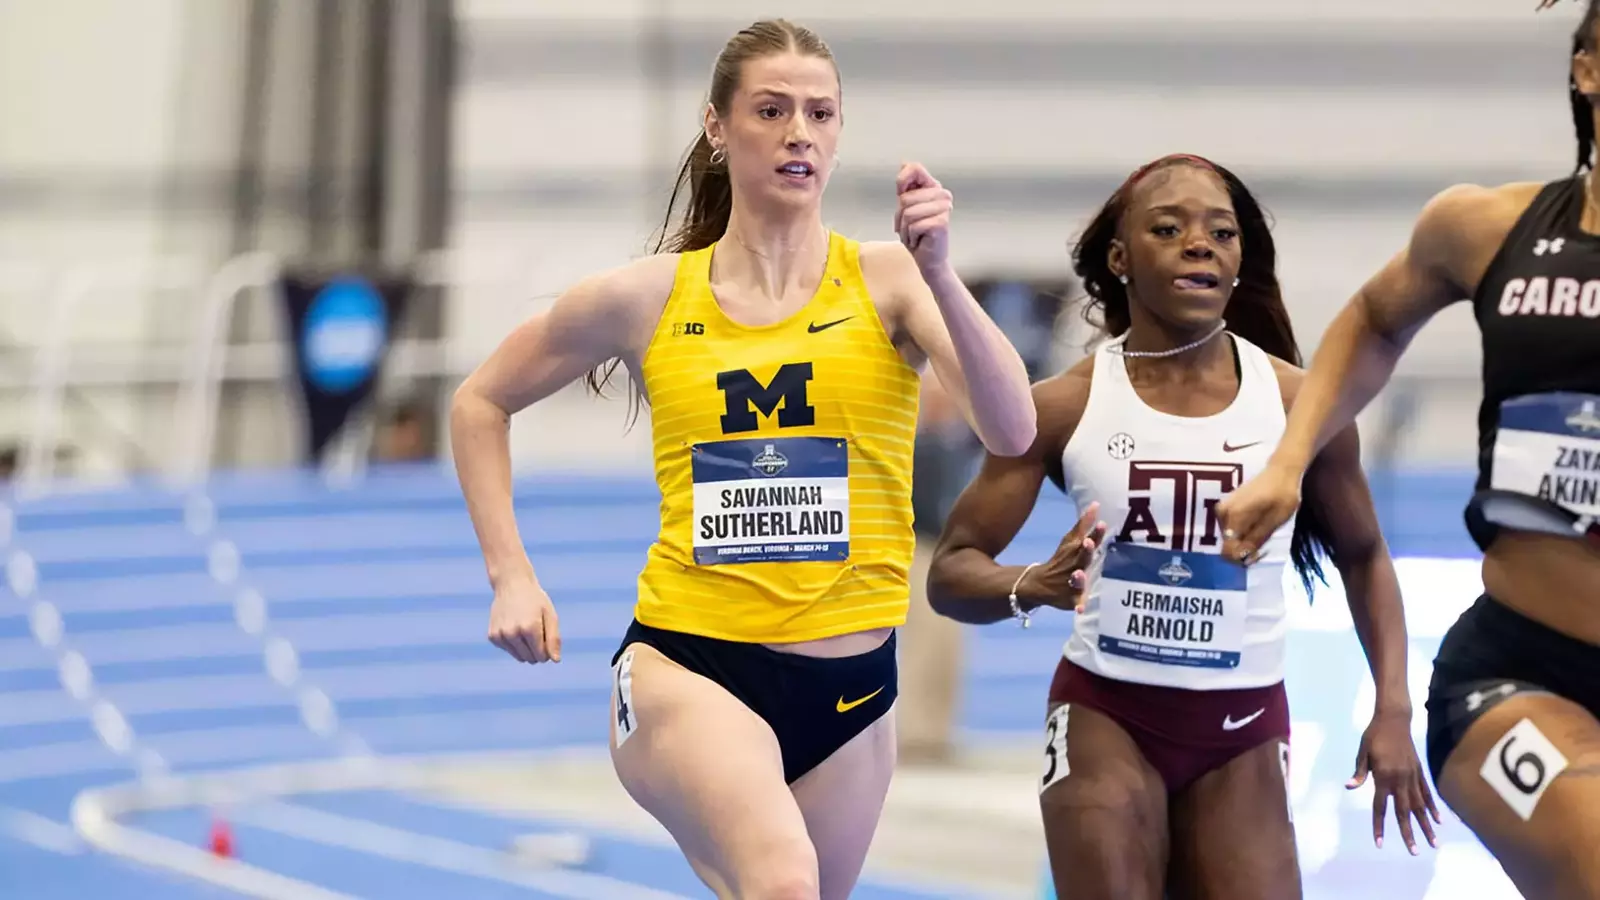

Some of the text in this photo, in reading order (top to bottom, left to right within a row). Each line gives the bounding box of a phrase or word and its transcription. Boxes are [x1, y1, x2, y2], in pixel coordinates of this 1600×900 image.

[1498, 277, 1600, 317] CARO
[717, 362, 815, 434] M
[1108, 432, 1135, 460] SEC
[720, 486, 822, 509] SAVANNAH
[700, 511, 843, 540] SUTHERLAND
[1121, 589, 1224, 616] JERMAISHA
[1126, 613, 1214, 643] ARNOLD
[1042, 715, 1057, 786] 3
[1499, 736, 1545, 795] 6
